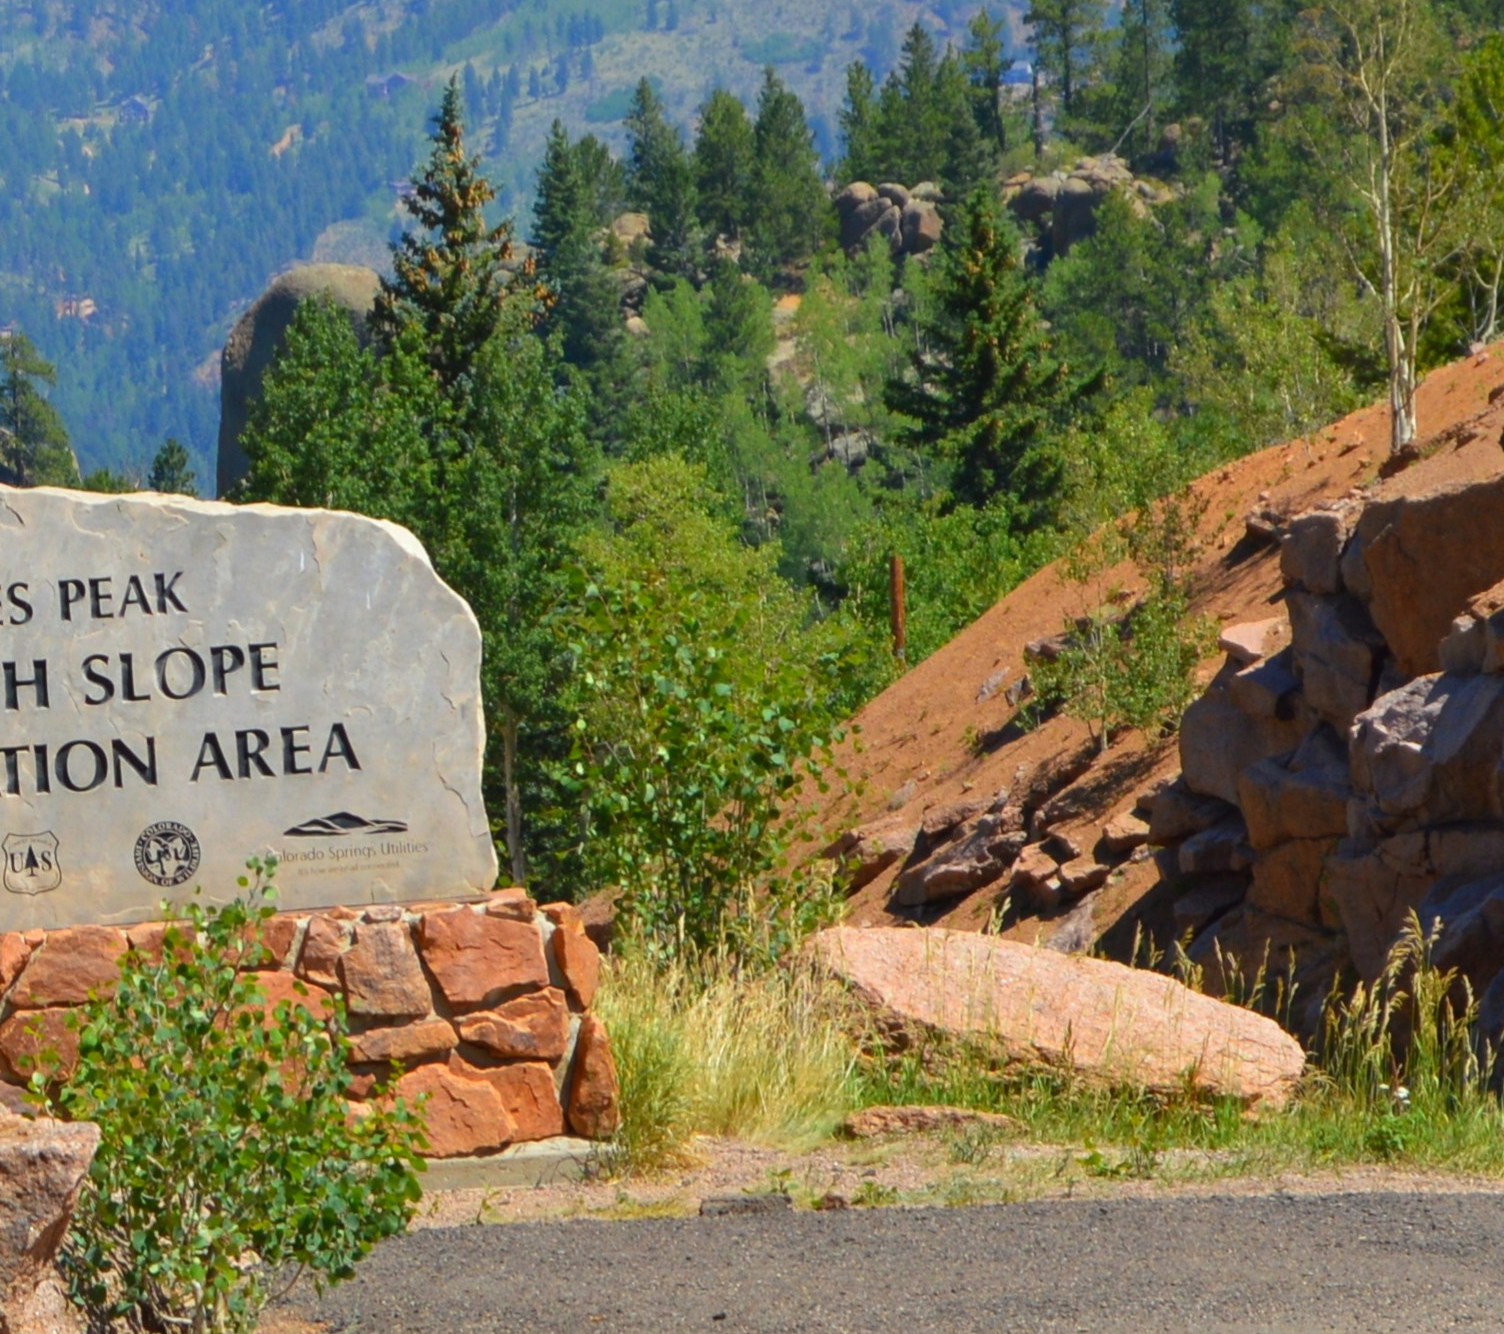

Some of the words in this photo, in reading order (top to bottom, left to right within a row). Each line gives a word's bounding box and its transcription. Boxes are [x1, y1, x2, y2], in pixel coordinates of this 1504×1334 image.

[58, 571, 189, 621] PEAK
[83, 642, 281, 706] SLOPE
[190, 722, 362, 784] AREA
[141, 822, 192, 841] COLORADO
[328, 845, 377, 861] Springs
[380, 840, 429, 856] Utilities
